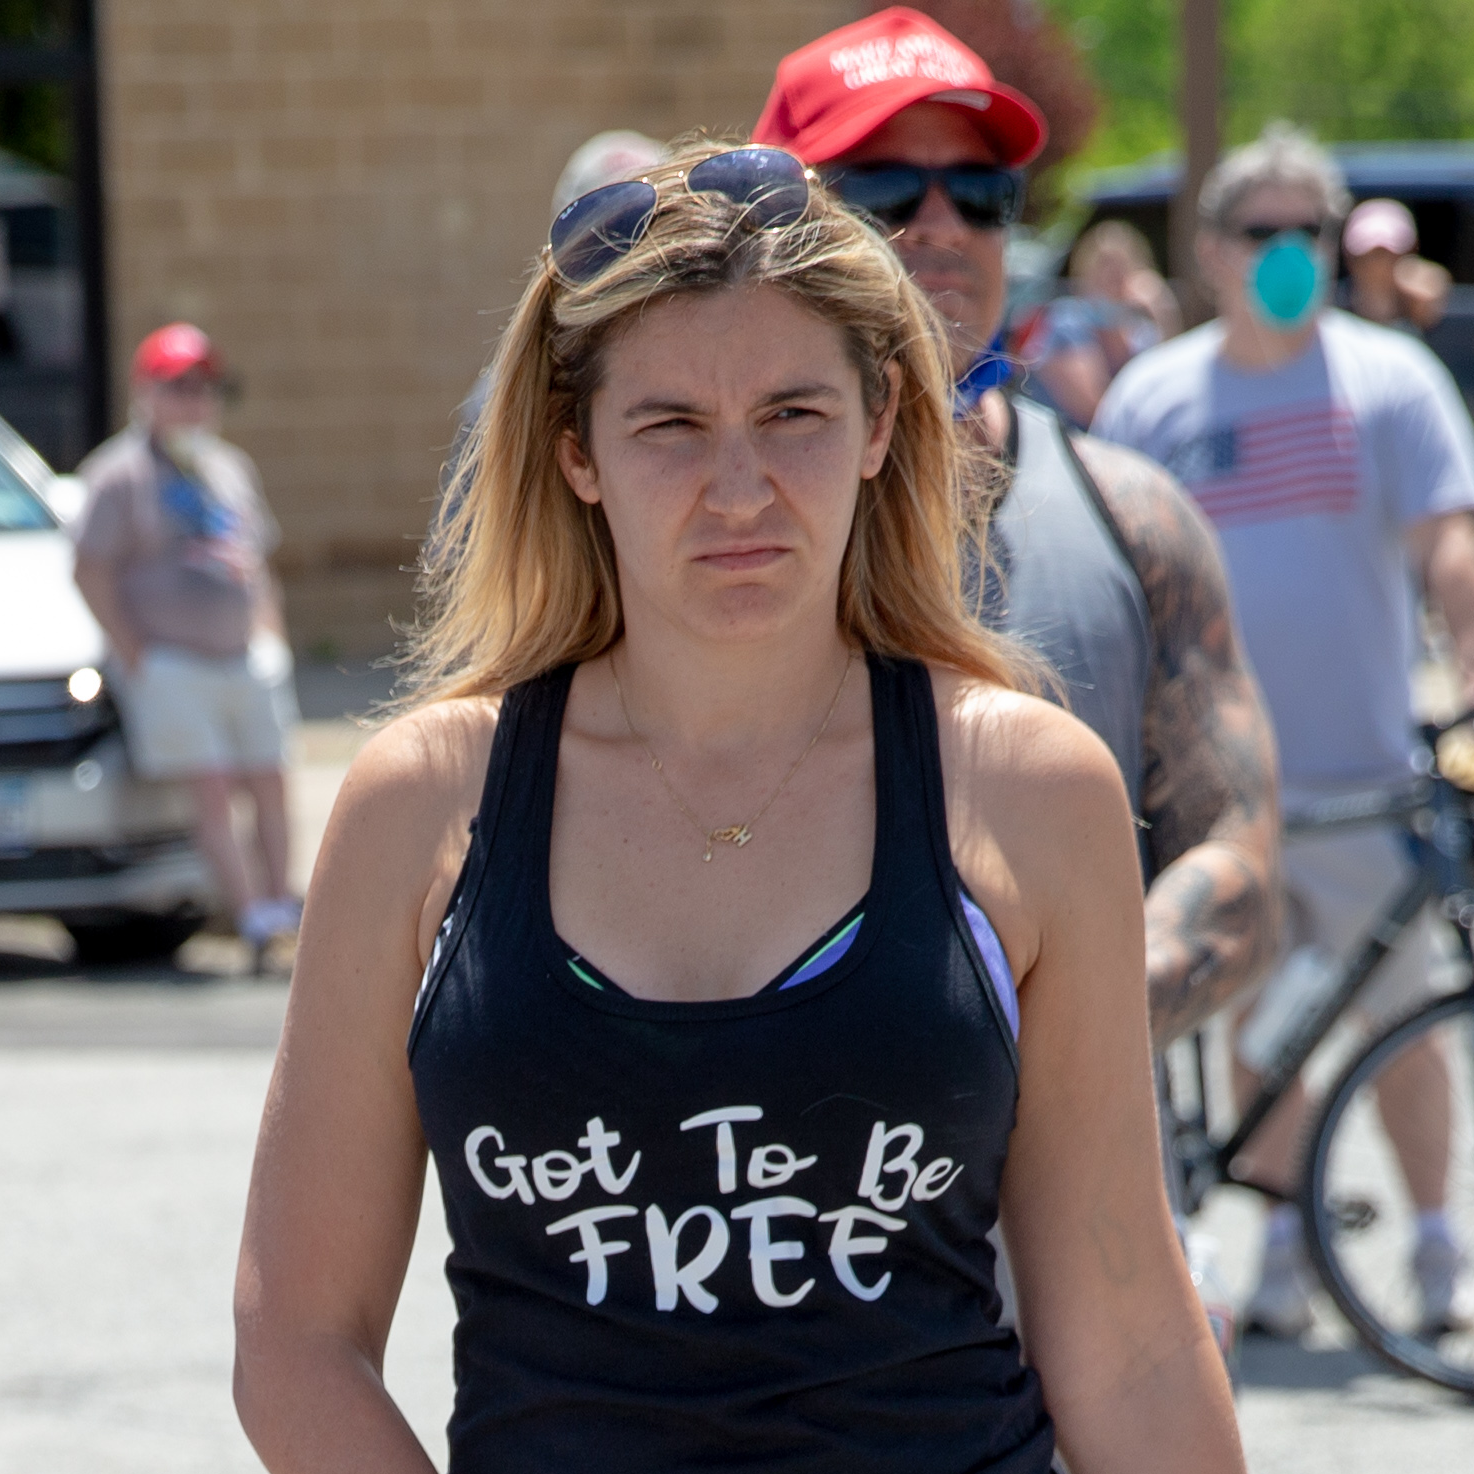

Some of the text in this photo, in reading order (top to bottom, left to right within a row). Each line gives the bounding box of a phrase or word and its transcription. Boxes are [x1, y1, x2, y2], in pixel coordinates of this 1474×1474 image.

[464, 1105, 964, 1212] Got To Be
[545, 1197, 908, 1314] FREE
